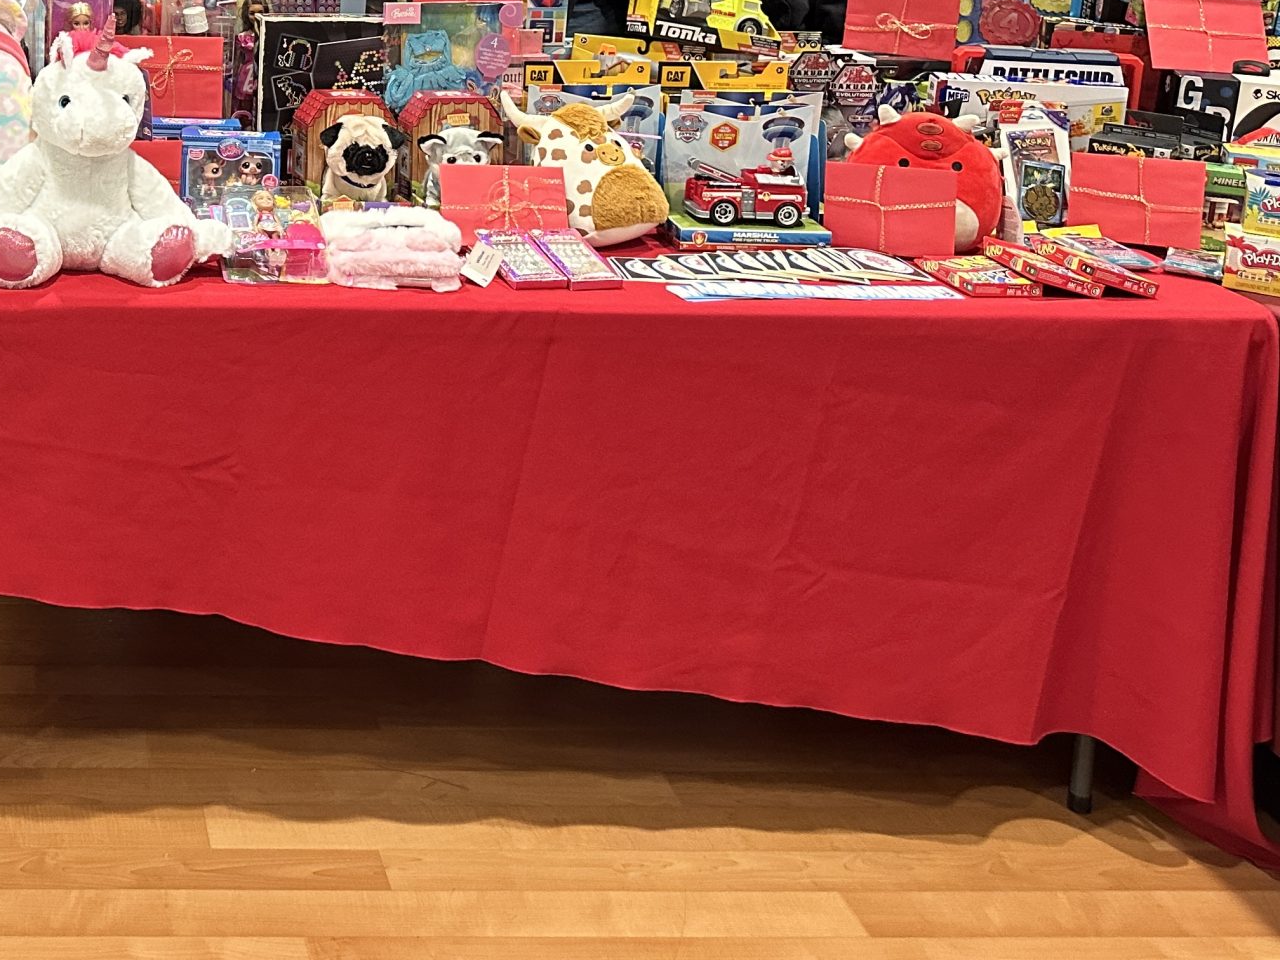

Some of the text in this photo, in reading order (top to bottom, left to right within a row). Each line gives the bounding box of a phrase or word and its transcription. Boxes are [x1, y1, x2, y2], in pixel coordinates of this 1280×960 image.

[390, 6, 417, 19] Barbie
[626, 22, 647, 33] Tonka
[656, 21, 717, 45] Tonka
[490, 37, 498, 48] 4
[529, 69, 548, 82] CAT
[665, 70, 685, 82] CAT
[788, 69, 837, 77] BAKUGAN
[829, 82, 883, 91] BAKUGAN
[947, 91, 969, 101] MEGA
[985, 245, 1004, 257] UNO
[1036, 243, 1056, 255] UNO
[922, 260, 939, 272] UNO
